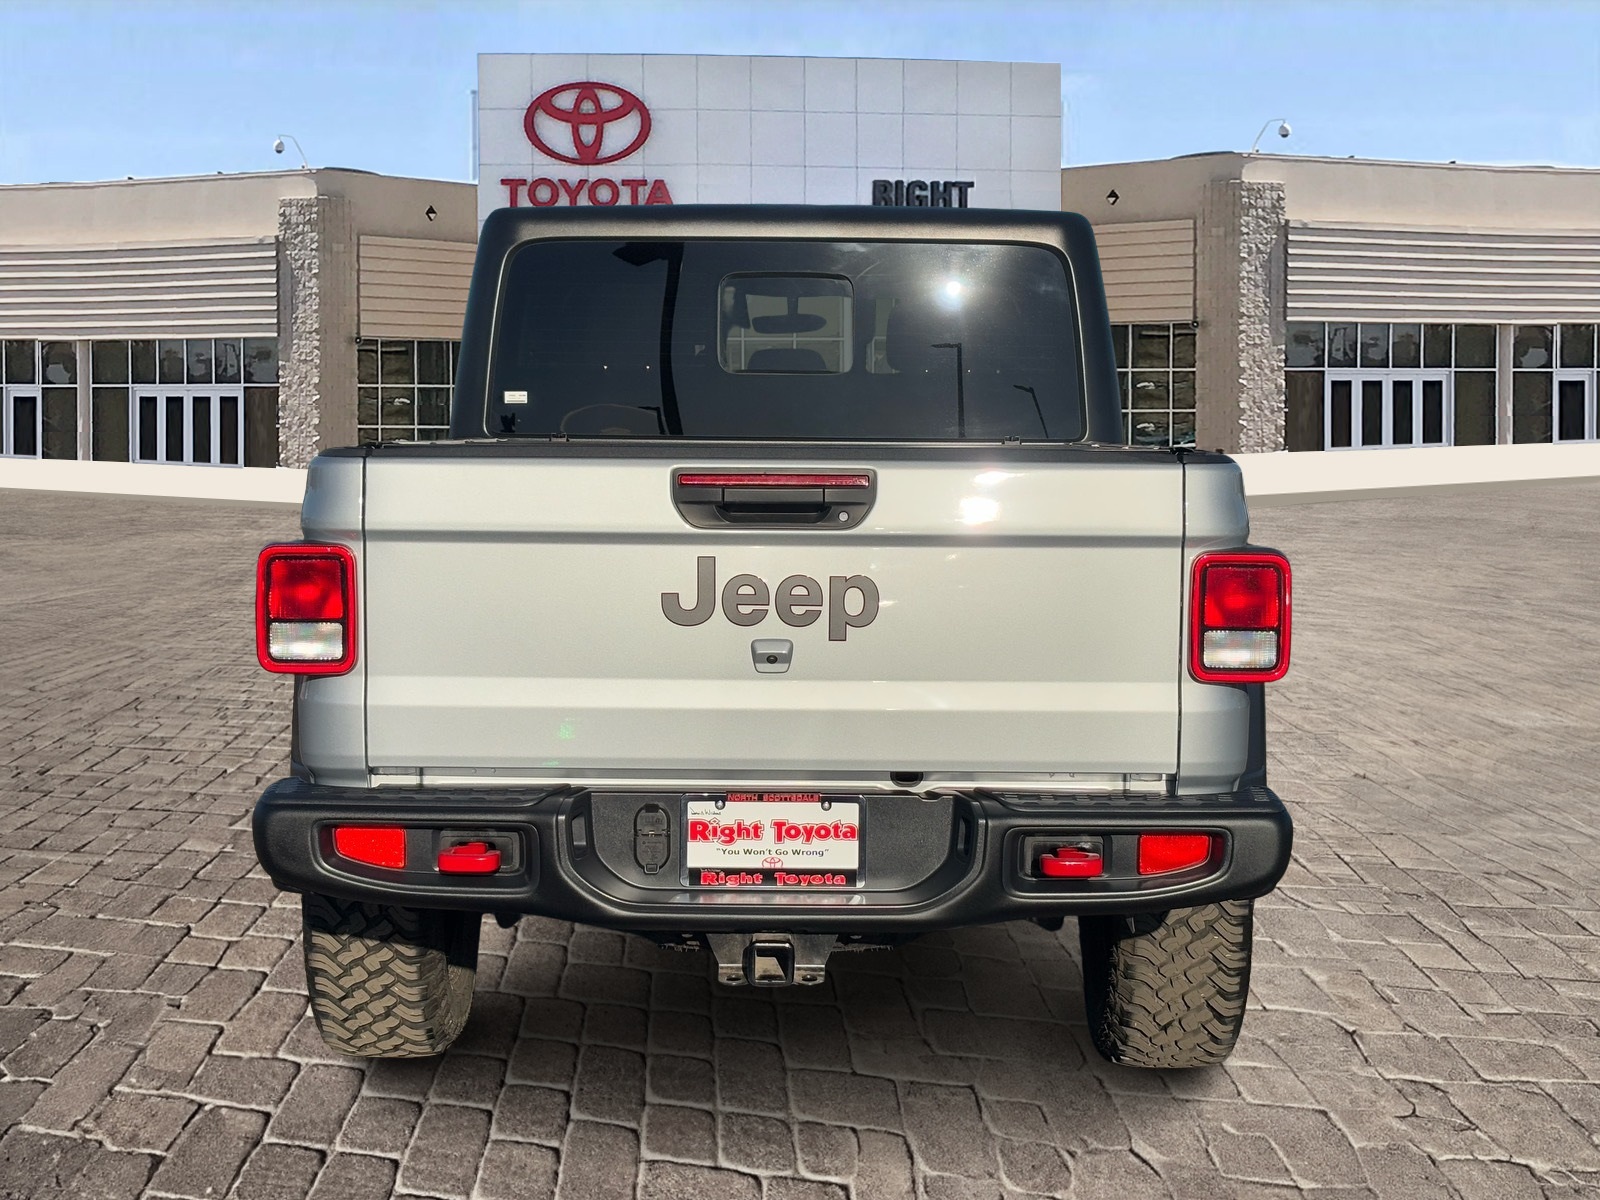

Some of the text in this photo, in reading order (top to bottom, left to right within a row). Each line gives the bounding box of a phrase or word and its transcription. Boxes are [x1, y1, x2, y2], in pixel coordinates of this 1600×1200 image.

[500, 178, 674, 207] TOYOTA
[872, 180, 975, 208] RIGHT
[661, 556, 880, 641] Jeep
[763, 794, 819, 802] SCOTTSDALE
[688, 818, 858, 846] Right Toyota
[775, 848, 789, 856] Go
[700, 871, 846, 887] Right Toyota
